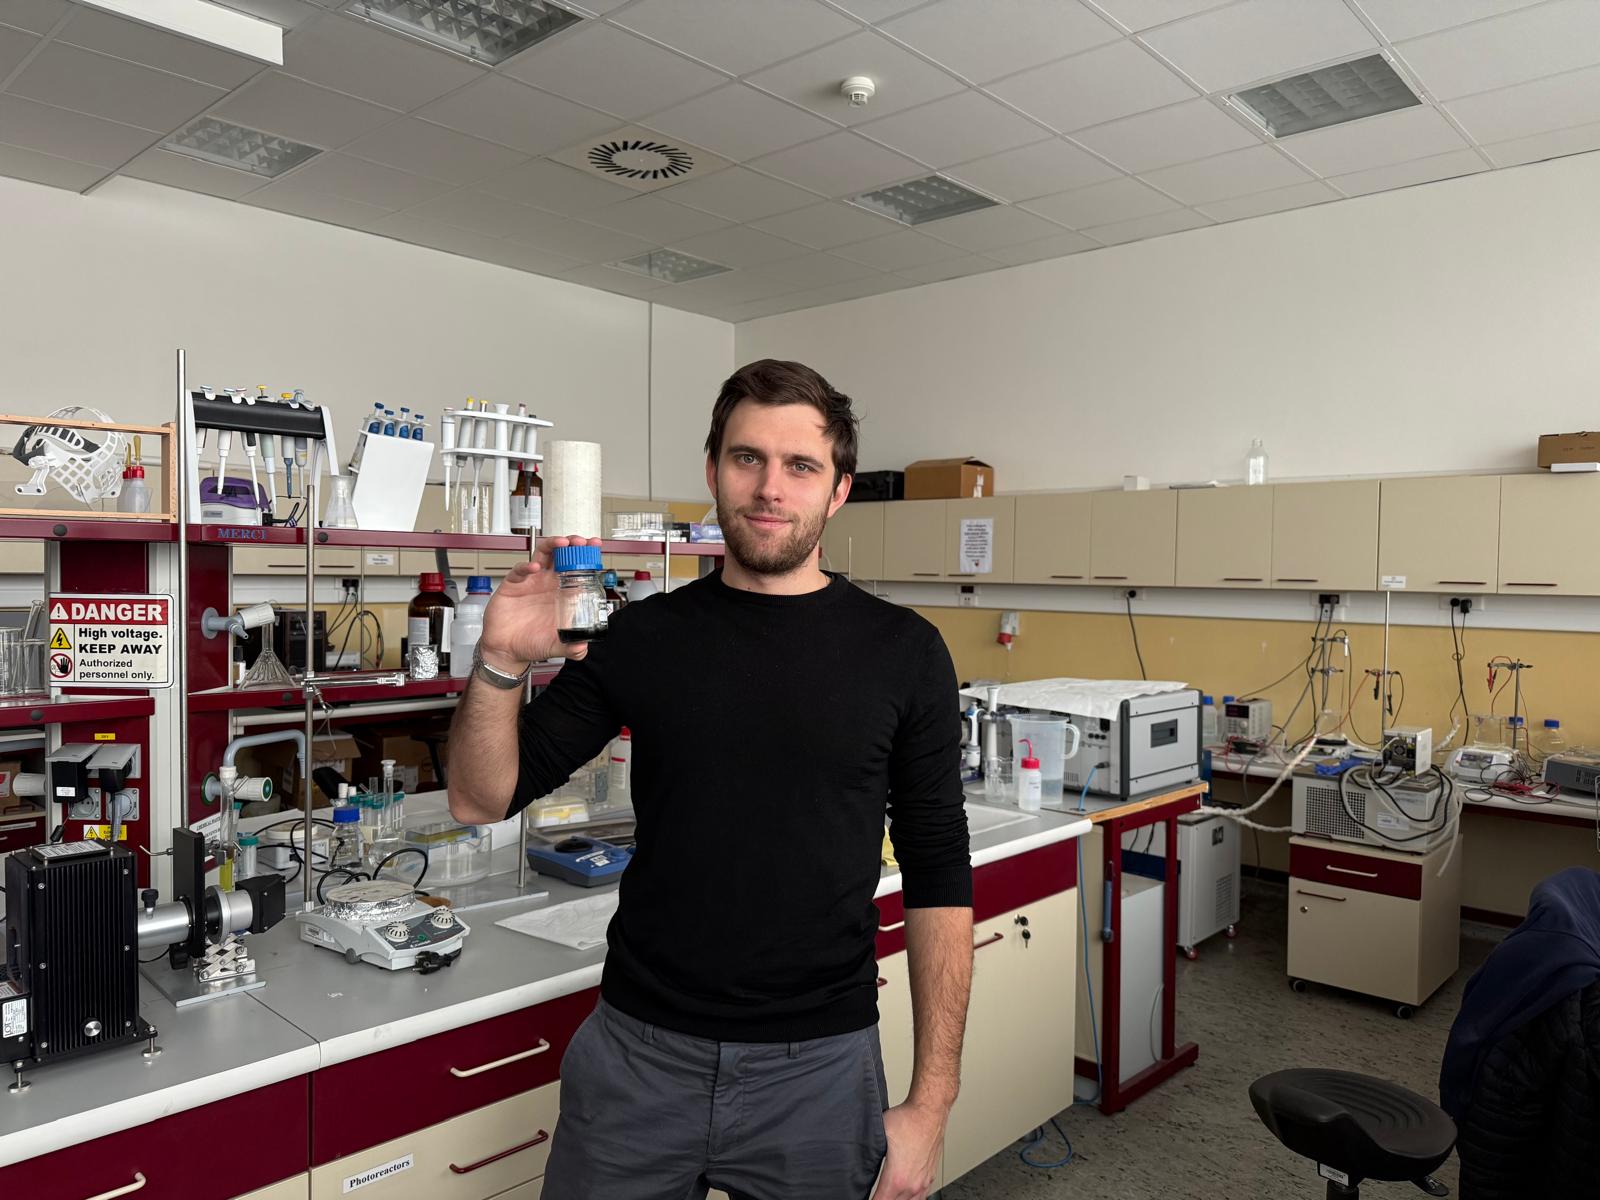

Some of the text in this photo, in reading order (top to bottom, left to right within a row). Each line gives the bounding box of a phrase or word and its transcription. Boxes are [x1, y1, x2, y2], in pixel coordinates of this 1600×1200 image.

[217, 528, 267, 540] MERCI
[71, 603, 163, 621] DANGER
[78, 627, 163, 641] High voltage.
[78, 644, 162, 654] KEEP AWAY
[79, 659, 133, 668] Authorized
[79, 671, 155, 680] personnel only.
[349, 1160, 410, 1188] Photoreactors
